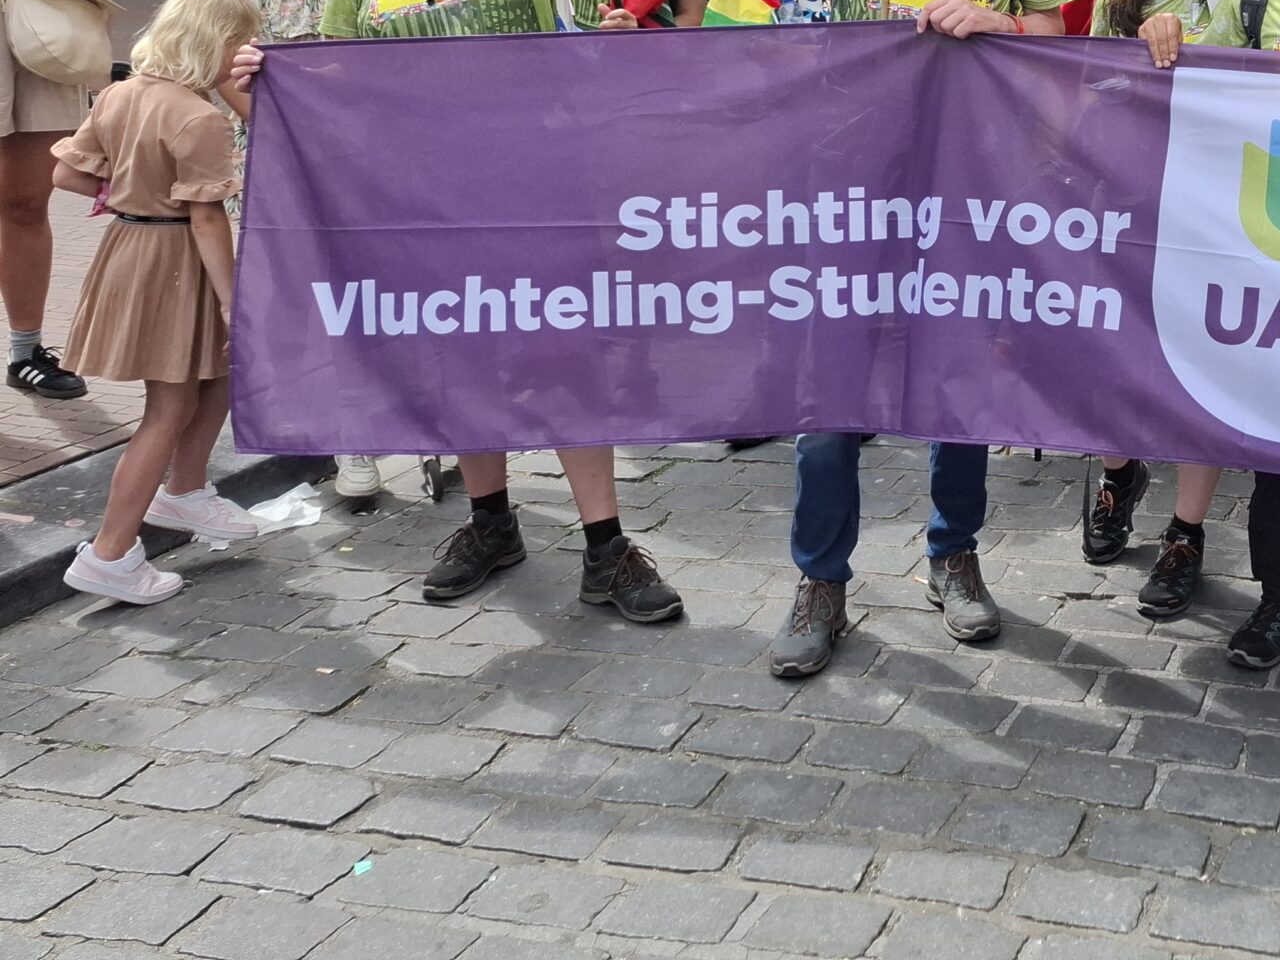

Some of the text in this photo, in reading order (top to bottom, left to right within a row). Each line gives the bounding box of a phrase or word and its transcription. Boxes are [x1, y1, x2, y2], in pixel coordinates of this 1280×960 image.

[616, 186, 1131, 253] Stichting voor
[311, 258, 1123, 336] Vluchteling-Studenten
